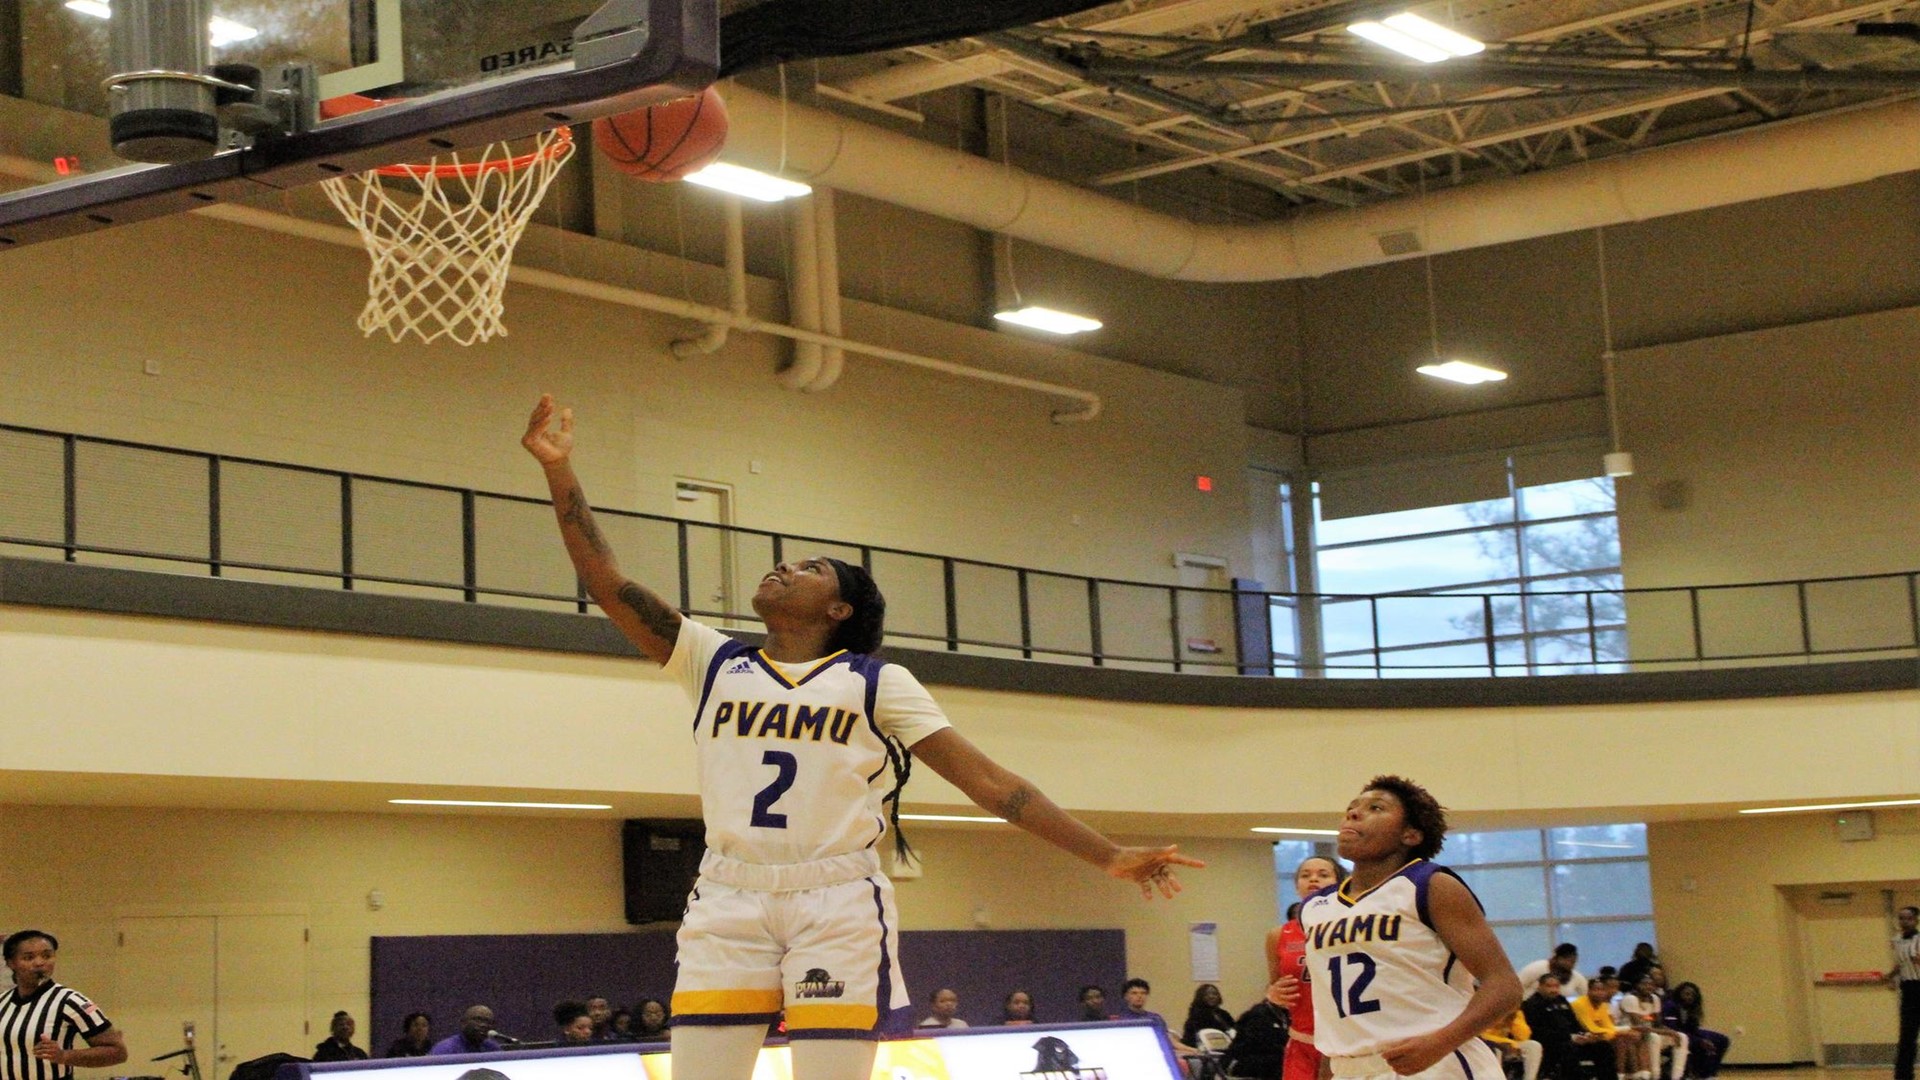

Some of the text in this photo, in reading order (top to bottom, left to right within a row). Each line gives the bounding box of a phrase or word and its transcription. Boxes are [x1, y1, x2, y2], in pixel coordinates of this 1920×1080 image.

[711, 700, 860, 746] PVAMU
[750, 750, 798, 829] 2
[1327, 951, 1381, 1018] 12
